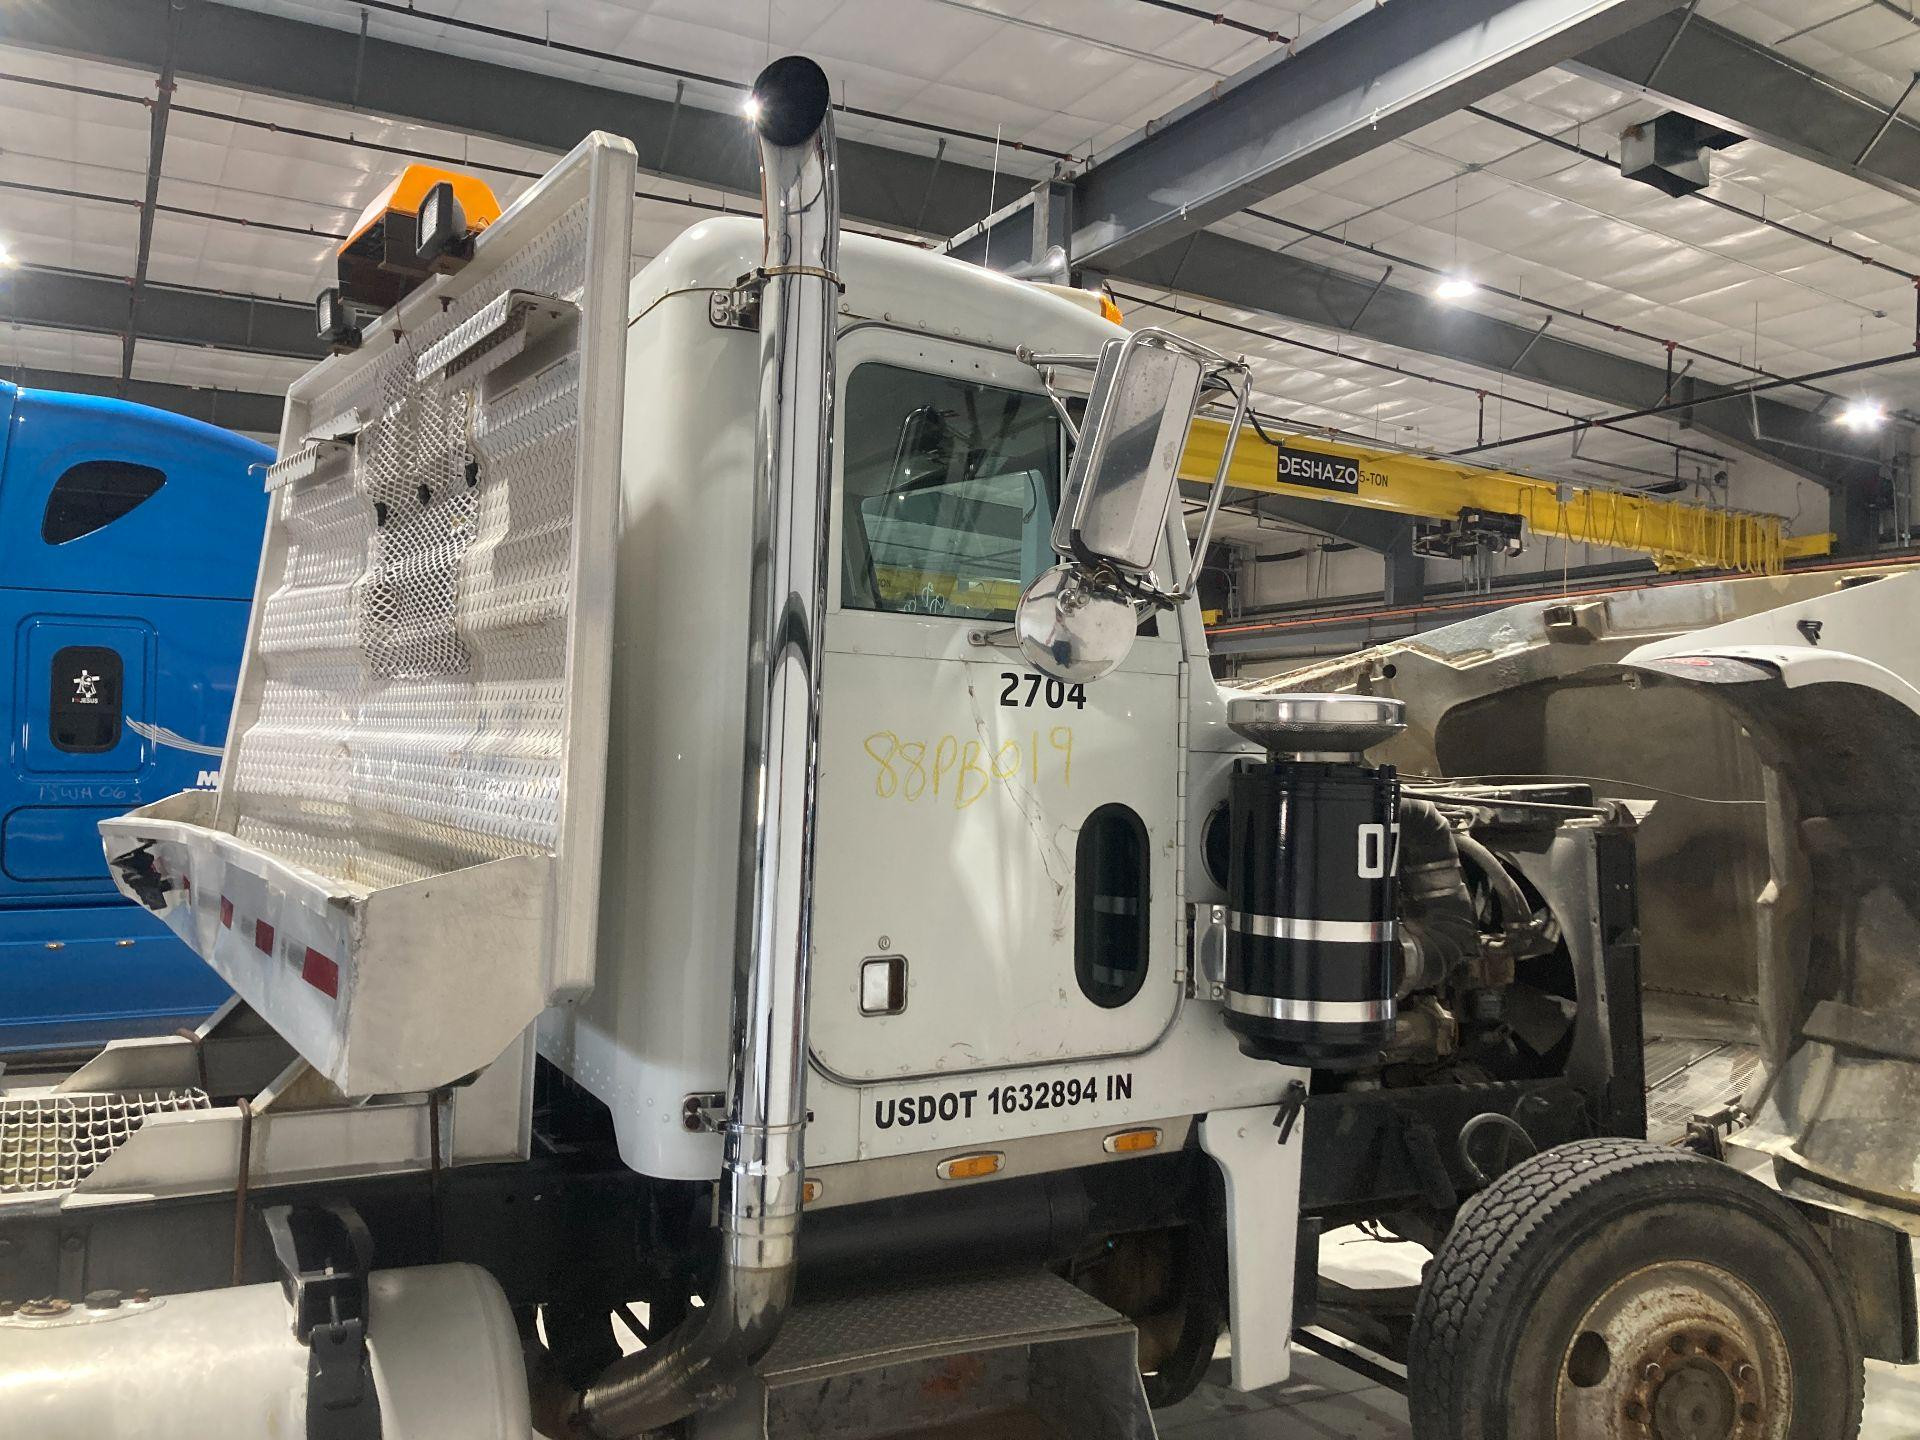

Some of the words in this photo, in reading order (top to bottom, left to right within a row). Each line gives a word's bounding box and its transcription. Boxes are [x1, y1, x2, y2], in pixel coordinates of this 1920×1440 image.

[1278, 455, 1358, 485] DESHAZO
[1000, 672, 1087, 710] 2704
[875, 1090, 978, 1129] USDOT
[987, 1077, 1098, 1115] 1632894
[1106, 1073, 1133, 1101] IN
